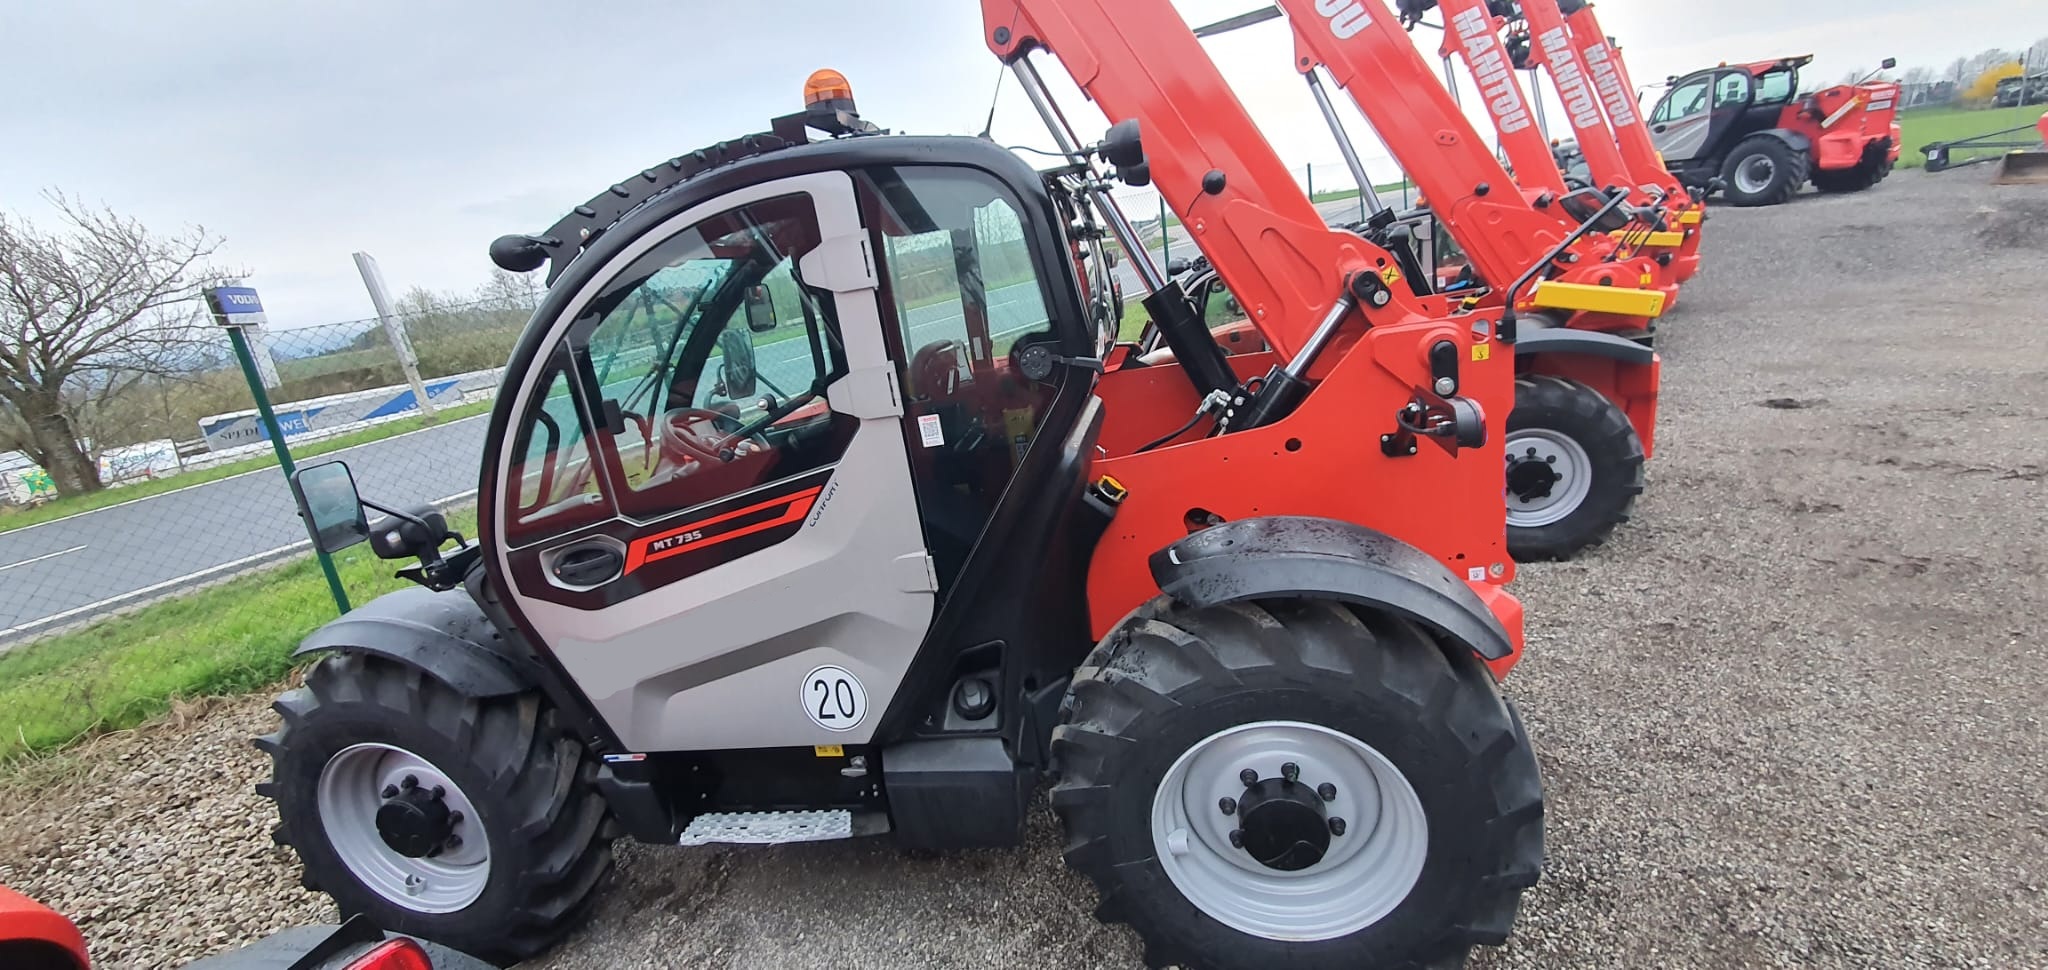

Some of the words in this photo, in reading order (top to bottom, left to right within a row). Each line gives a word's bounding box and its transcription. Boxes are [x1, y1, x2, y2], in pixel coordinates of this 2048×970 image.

[1453, 8, 1530, 133] MANITOU
[1539, 27, 1600, 128] MANITOU
[1584, 44, 1636, 127] MANITOU
[653, 537, 673, 551] MT
[675, 531, 702, 544] 735
[814, 679, 855, 719] 20
